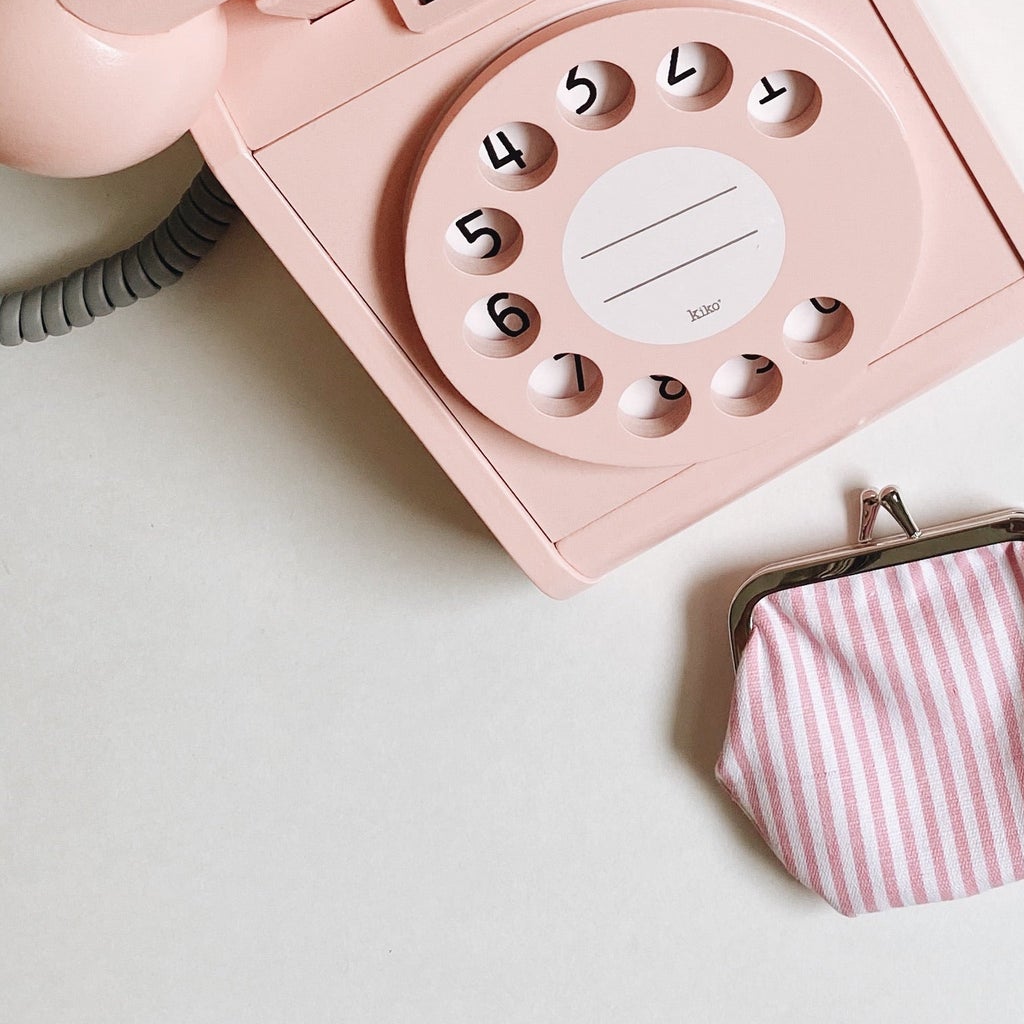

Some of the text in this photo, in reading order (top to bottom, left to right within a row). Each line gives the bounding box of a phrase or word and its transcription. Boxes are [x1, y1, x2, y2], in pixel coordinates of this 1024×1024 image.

[482, 131, 527, 170] 4
[455, 209, 502, 259] 5
[486, 292, 531, 338] 6
[687, 302, 720, 322] kiko
[553, 352, 586, 392] 7
